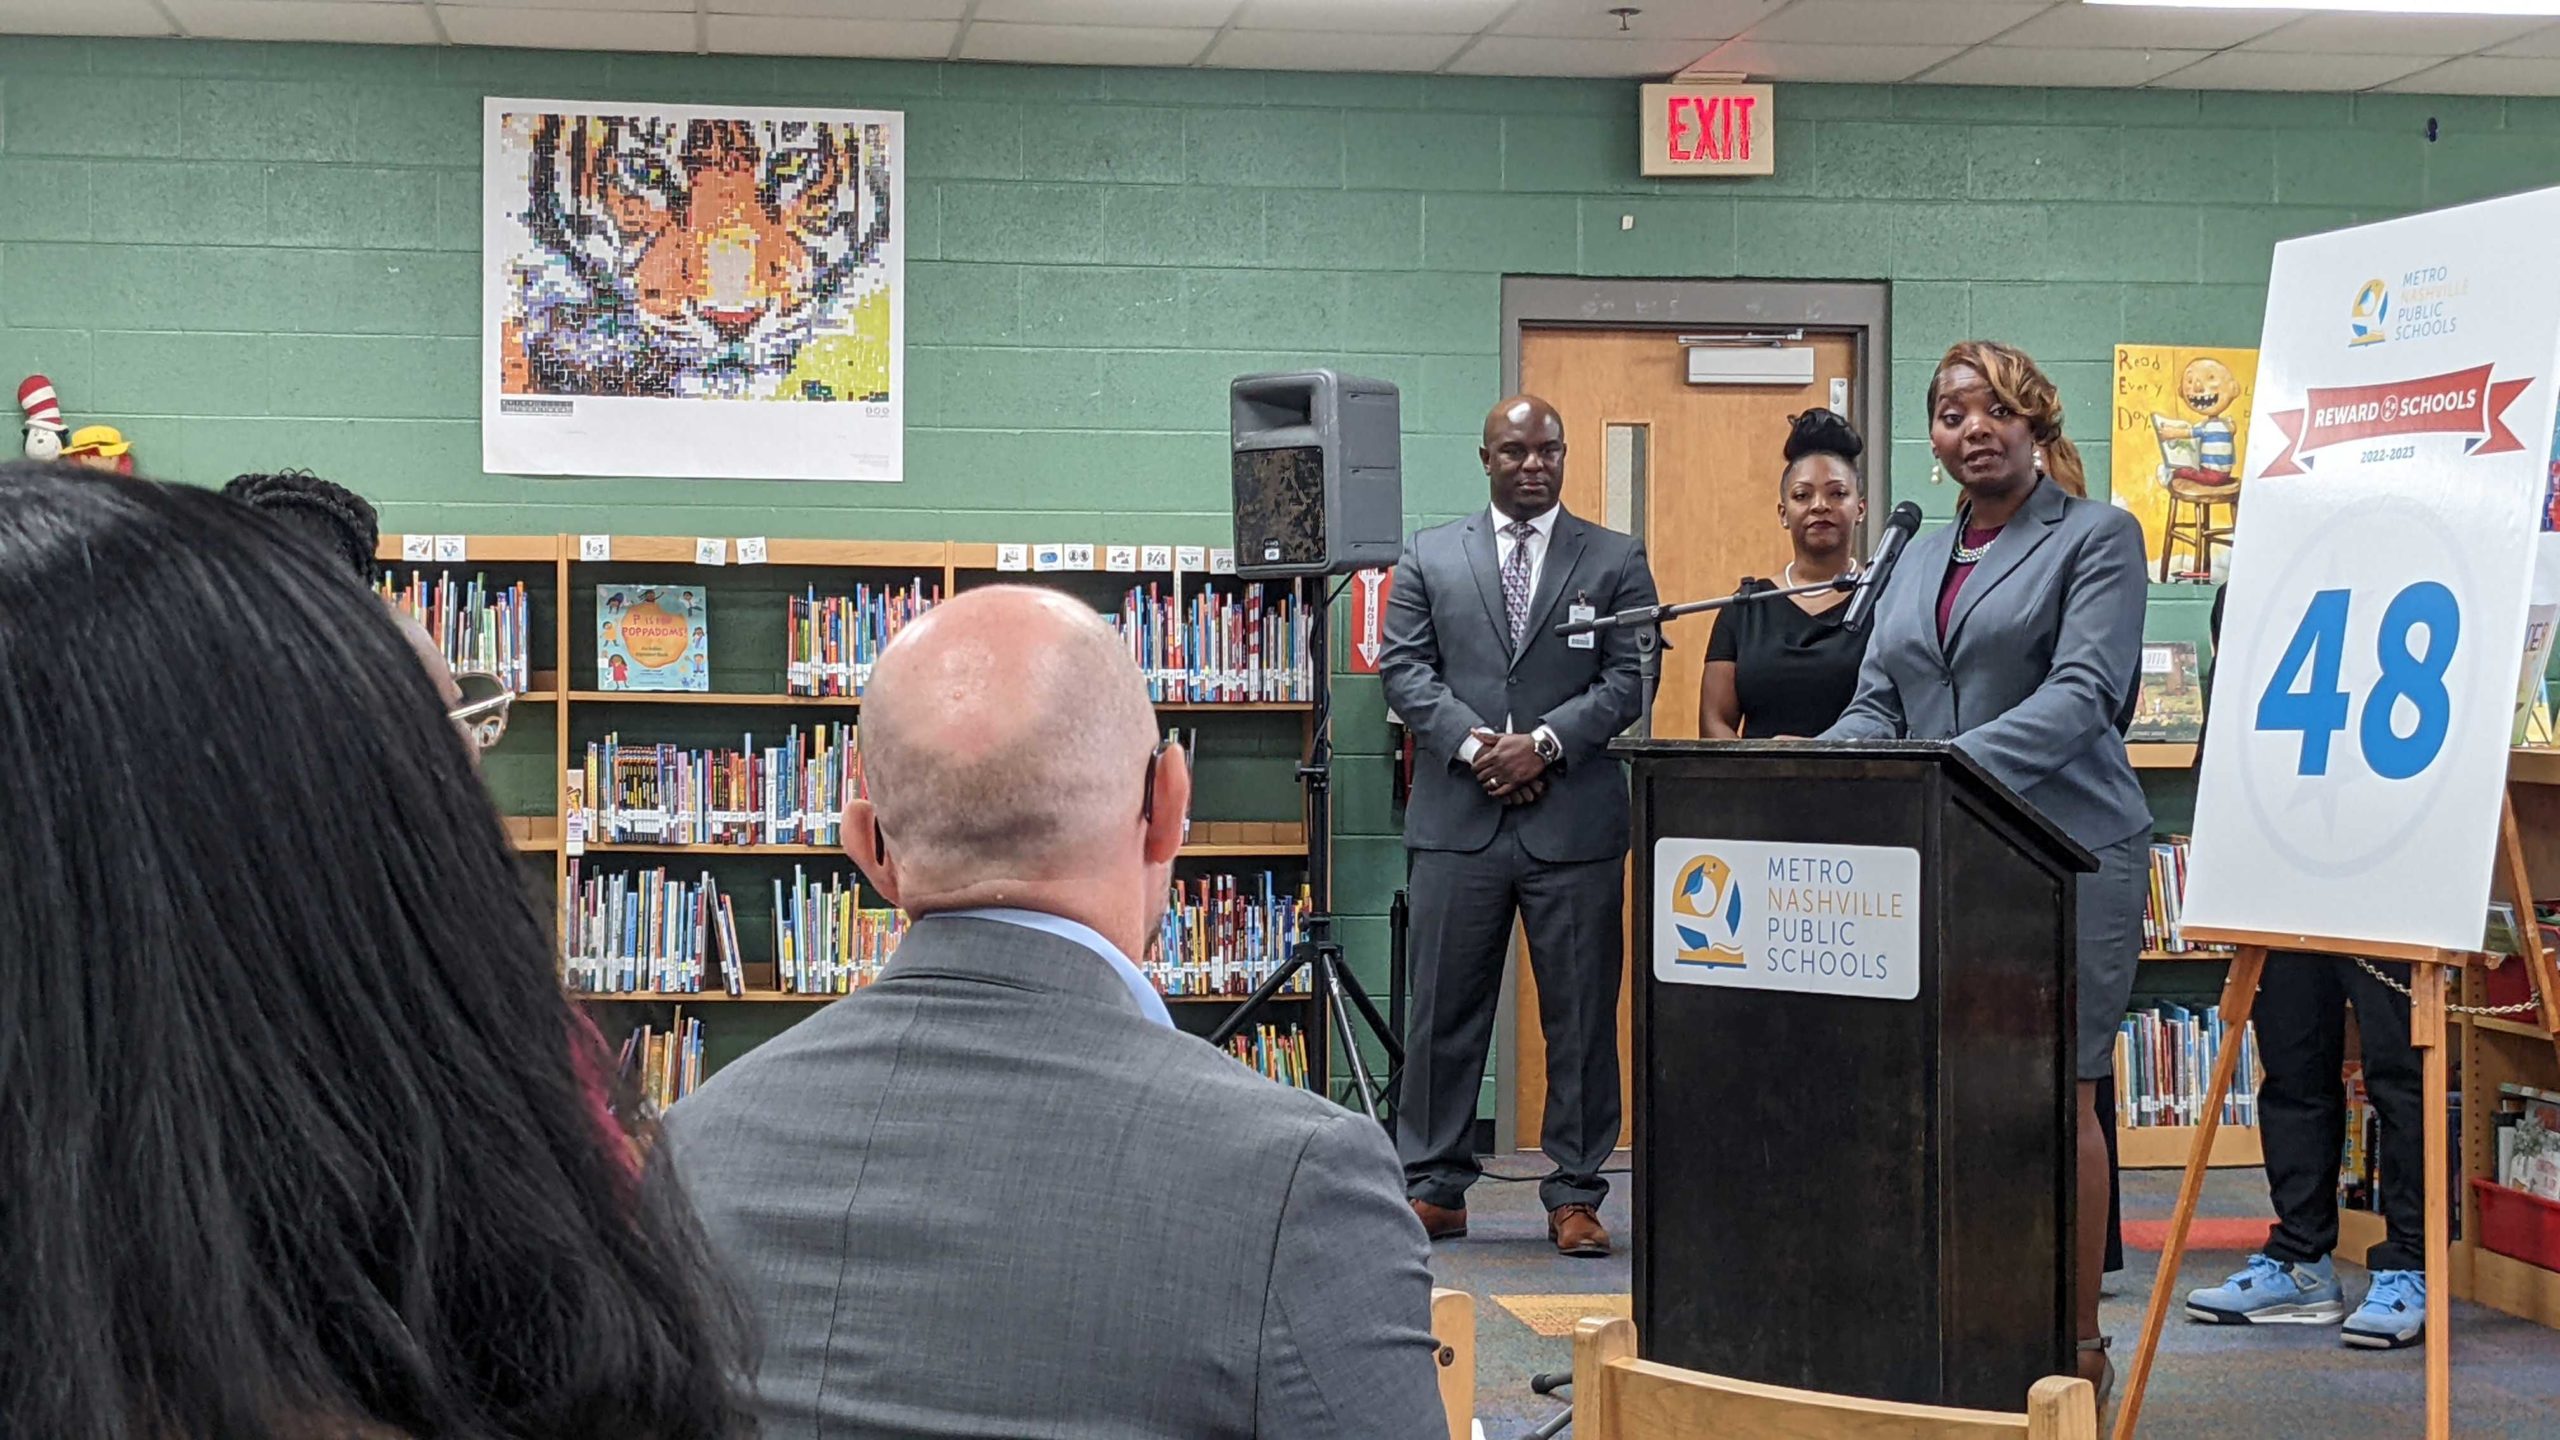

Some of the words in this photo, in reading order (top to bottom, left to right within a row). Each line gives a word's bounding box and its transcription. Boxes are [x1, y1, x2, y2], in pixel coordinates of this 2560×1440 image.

[1668, 97, 1755, 160] EXIT
[2401, 276, 2469, 302] NASHVILLE
[2403, 266, 2447, 287] METRO
[2398, 301, 2443, 322] PUBLIC
[2395, 317, 2456, 341] SCHOOLS
[2119, 349, 2160, 371] Read
[2119, 377, 2163, 395] Every
[2314, 402, 2379, 428] REWARD
[2399, 388, 2477, 417] SCHOOLS
[2360, 446, 2415, 463] 2022-2023
[1367, 578, 1375, 660] EXTINGUISHER
[2255, 581, 2460, 780] 48
[1768, 857, 1853, 884] METRO
[1768, 887, 1903, 918] NASHVILLE
[1768, 917, 1855, 946] PUBLIC
[1767, 947, 1888, 980] SCHOOLS
